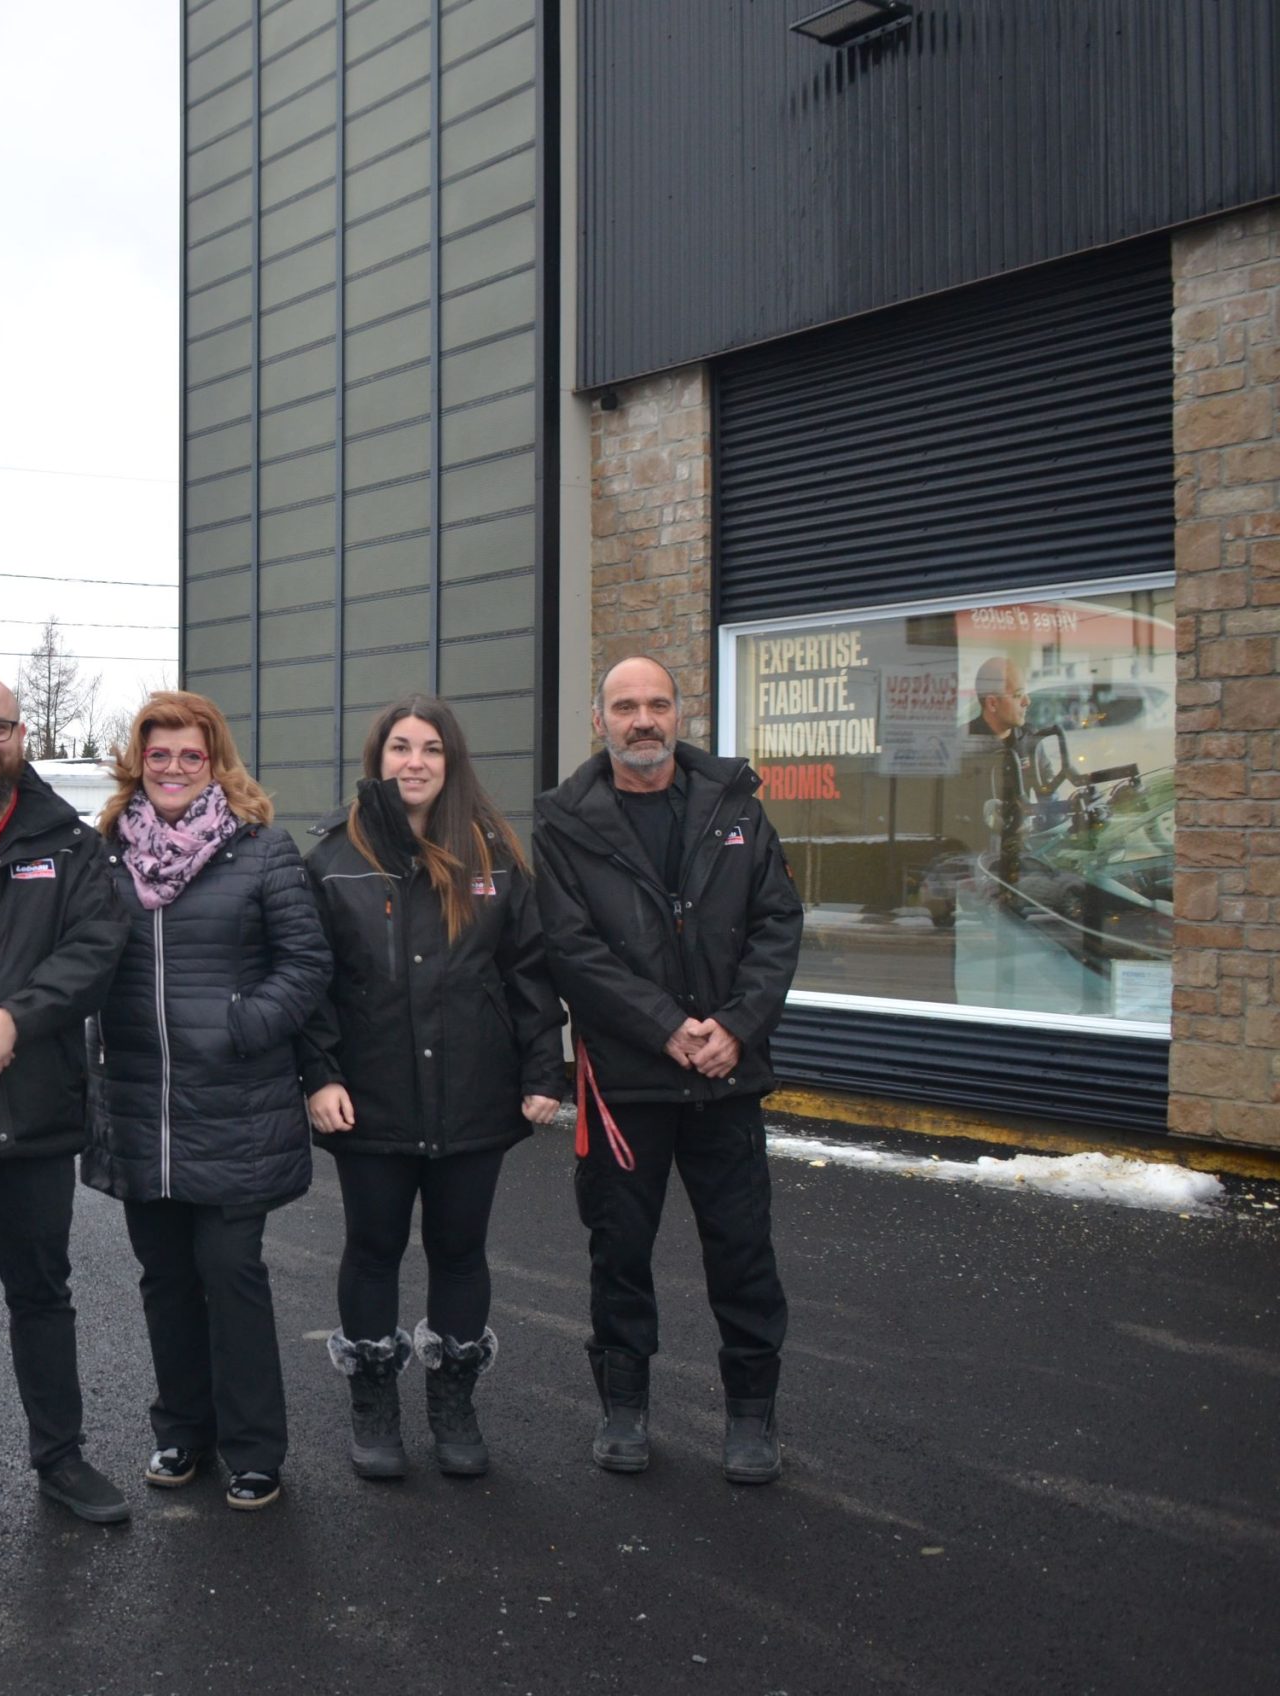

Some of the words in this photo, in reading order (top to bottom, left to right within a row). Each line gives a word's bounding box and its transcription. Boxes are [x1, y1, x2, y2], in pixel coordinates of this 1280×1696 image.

[758, 631, 869, 675] EXPERTISE.
[758, 668, 855, 717] FIABILITÉ.
[757, 717, 882, 758] INNOVATION.
[758, 763, 841, 800] PROMIS.
